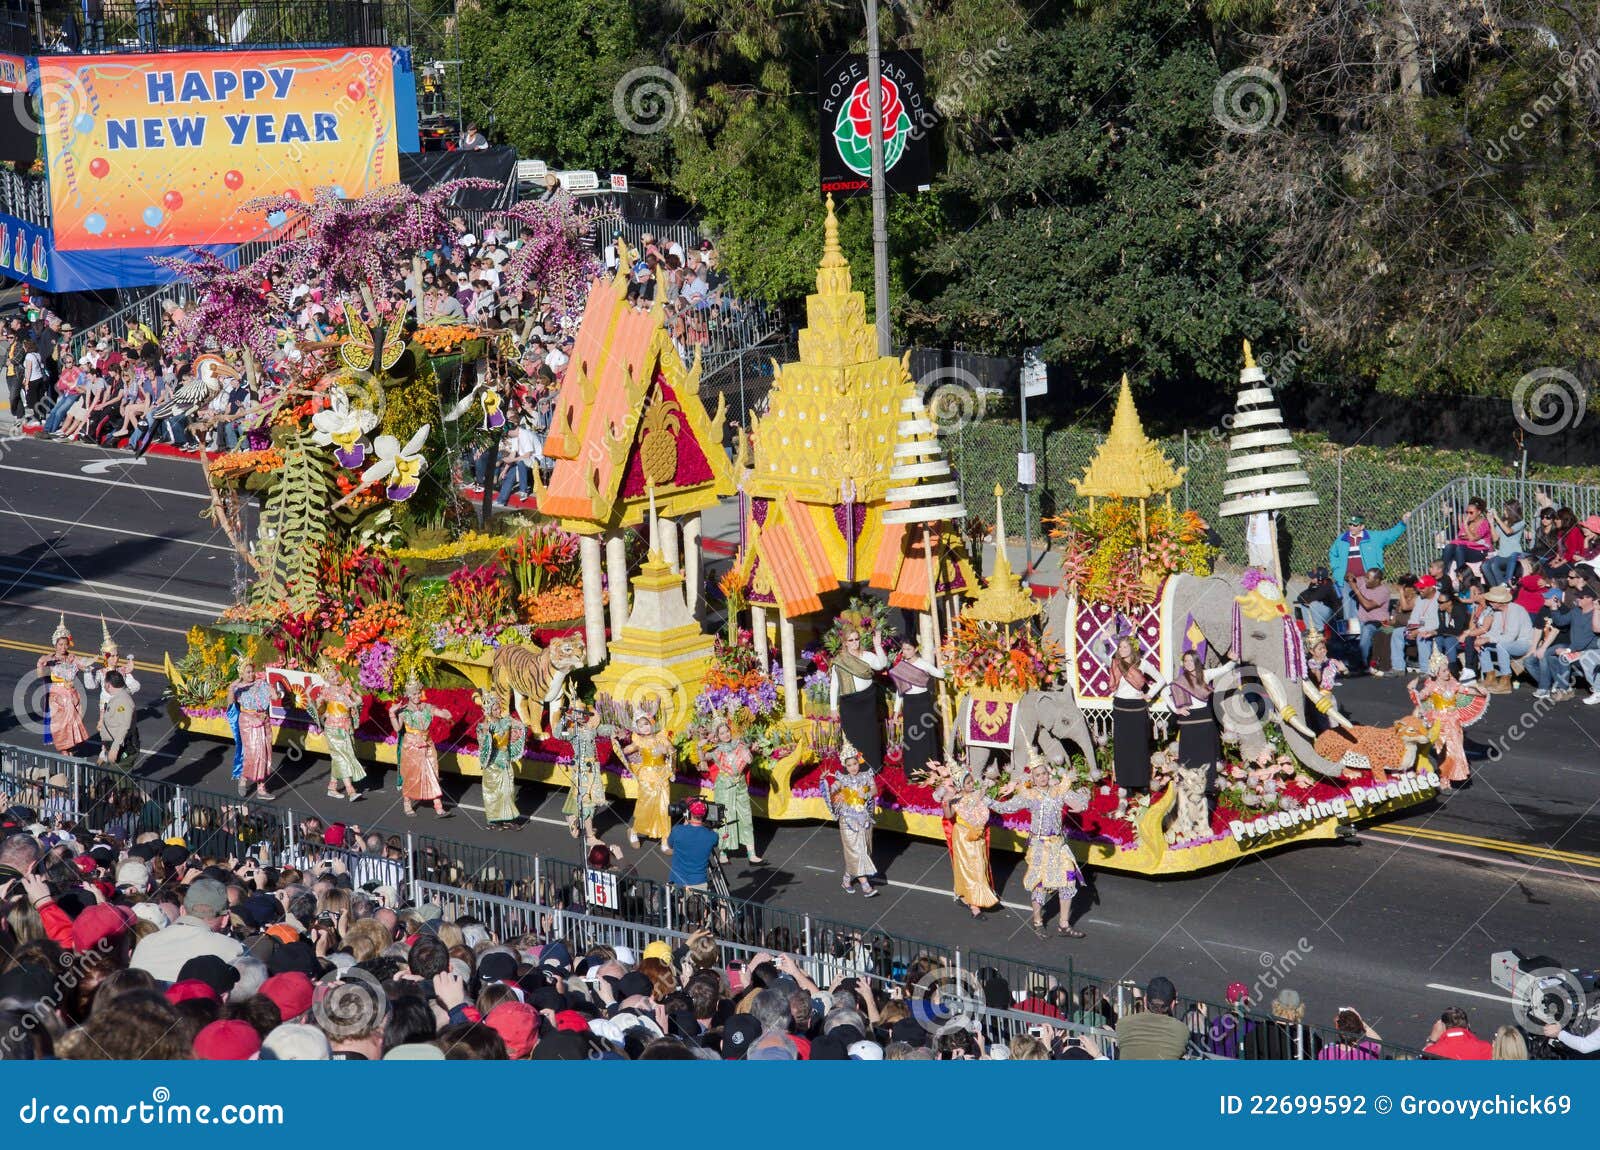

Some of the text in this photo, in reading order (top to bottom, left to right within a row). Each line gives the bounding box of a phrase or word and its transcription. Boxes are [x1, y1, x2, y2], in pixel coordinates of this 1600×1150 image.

[145, 67, 296, 104] HAPPY
[823, 62, 861, 113] ROSE
[106, 112, 340, 149] NEW YEAR
[822, 180, 869, 192] HONDA
[1229, 771, 1440, 841] Preserving Paradise
[596, 885, 607, 904] 5
